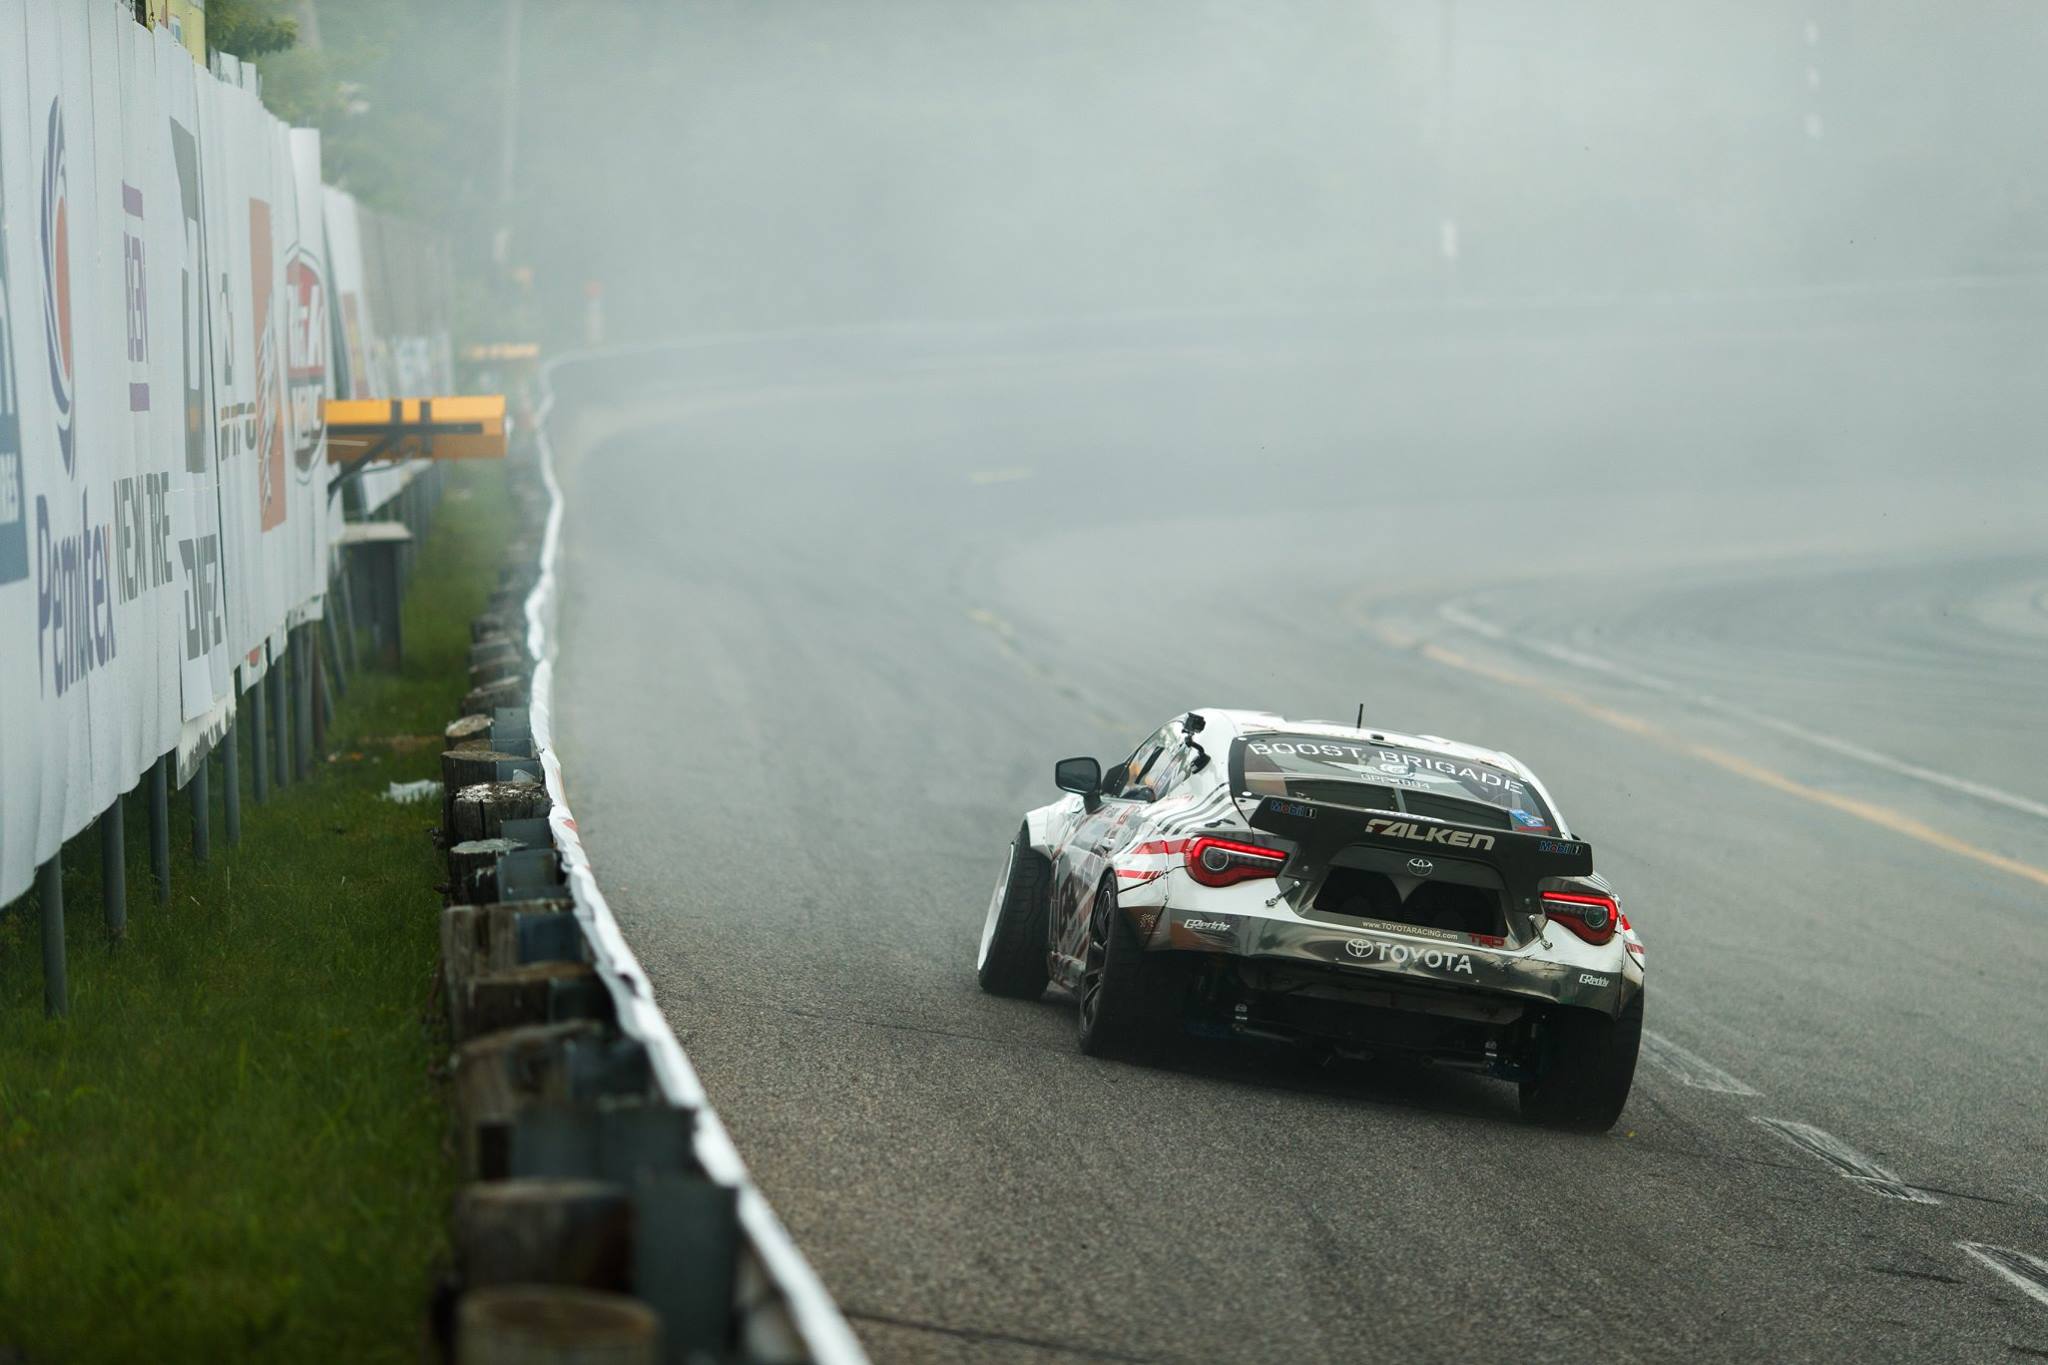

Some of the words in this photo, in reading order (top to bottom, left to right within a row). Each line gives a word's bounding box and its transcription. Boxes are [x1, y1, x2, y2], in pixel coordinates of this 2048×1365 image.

[113, 474, 148, 605] NEXN
[146, 471, 173, 588] TRE
[36, 485, 117, 699] Pemtex
[1248, 743, 1363, 758] BOOST
[1378, 750, 1525, 795] BRIGADE
[1271, 800, 1305, 818] Mobil
[1364, 819, 1496, 851] FALKEN
[1539, 840, 1571, 855] Mobil
[1183, 918, 1231, 932] GReddy
[1362, 920, 1458, 941] www.TOYOTARACING.com
[1468, 932, 1505, 948] TRD
[1375, 941, 1473, 975] TOYOTA
[1579, 973, 1609, 988] GReddy
